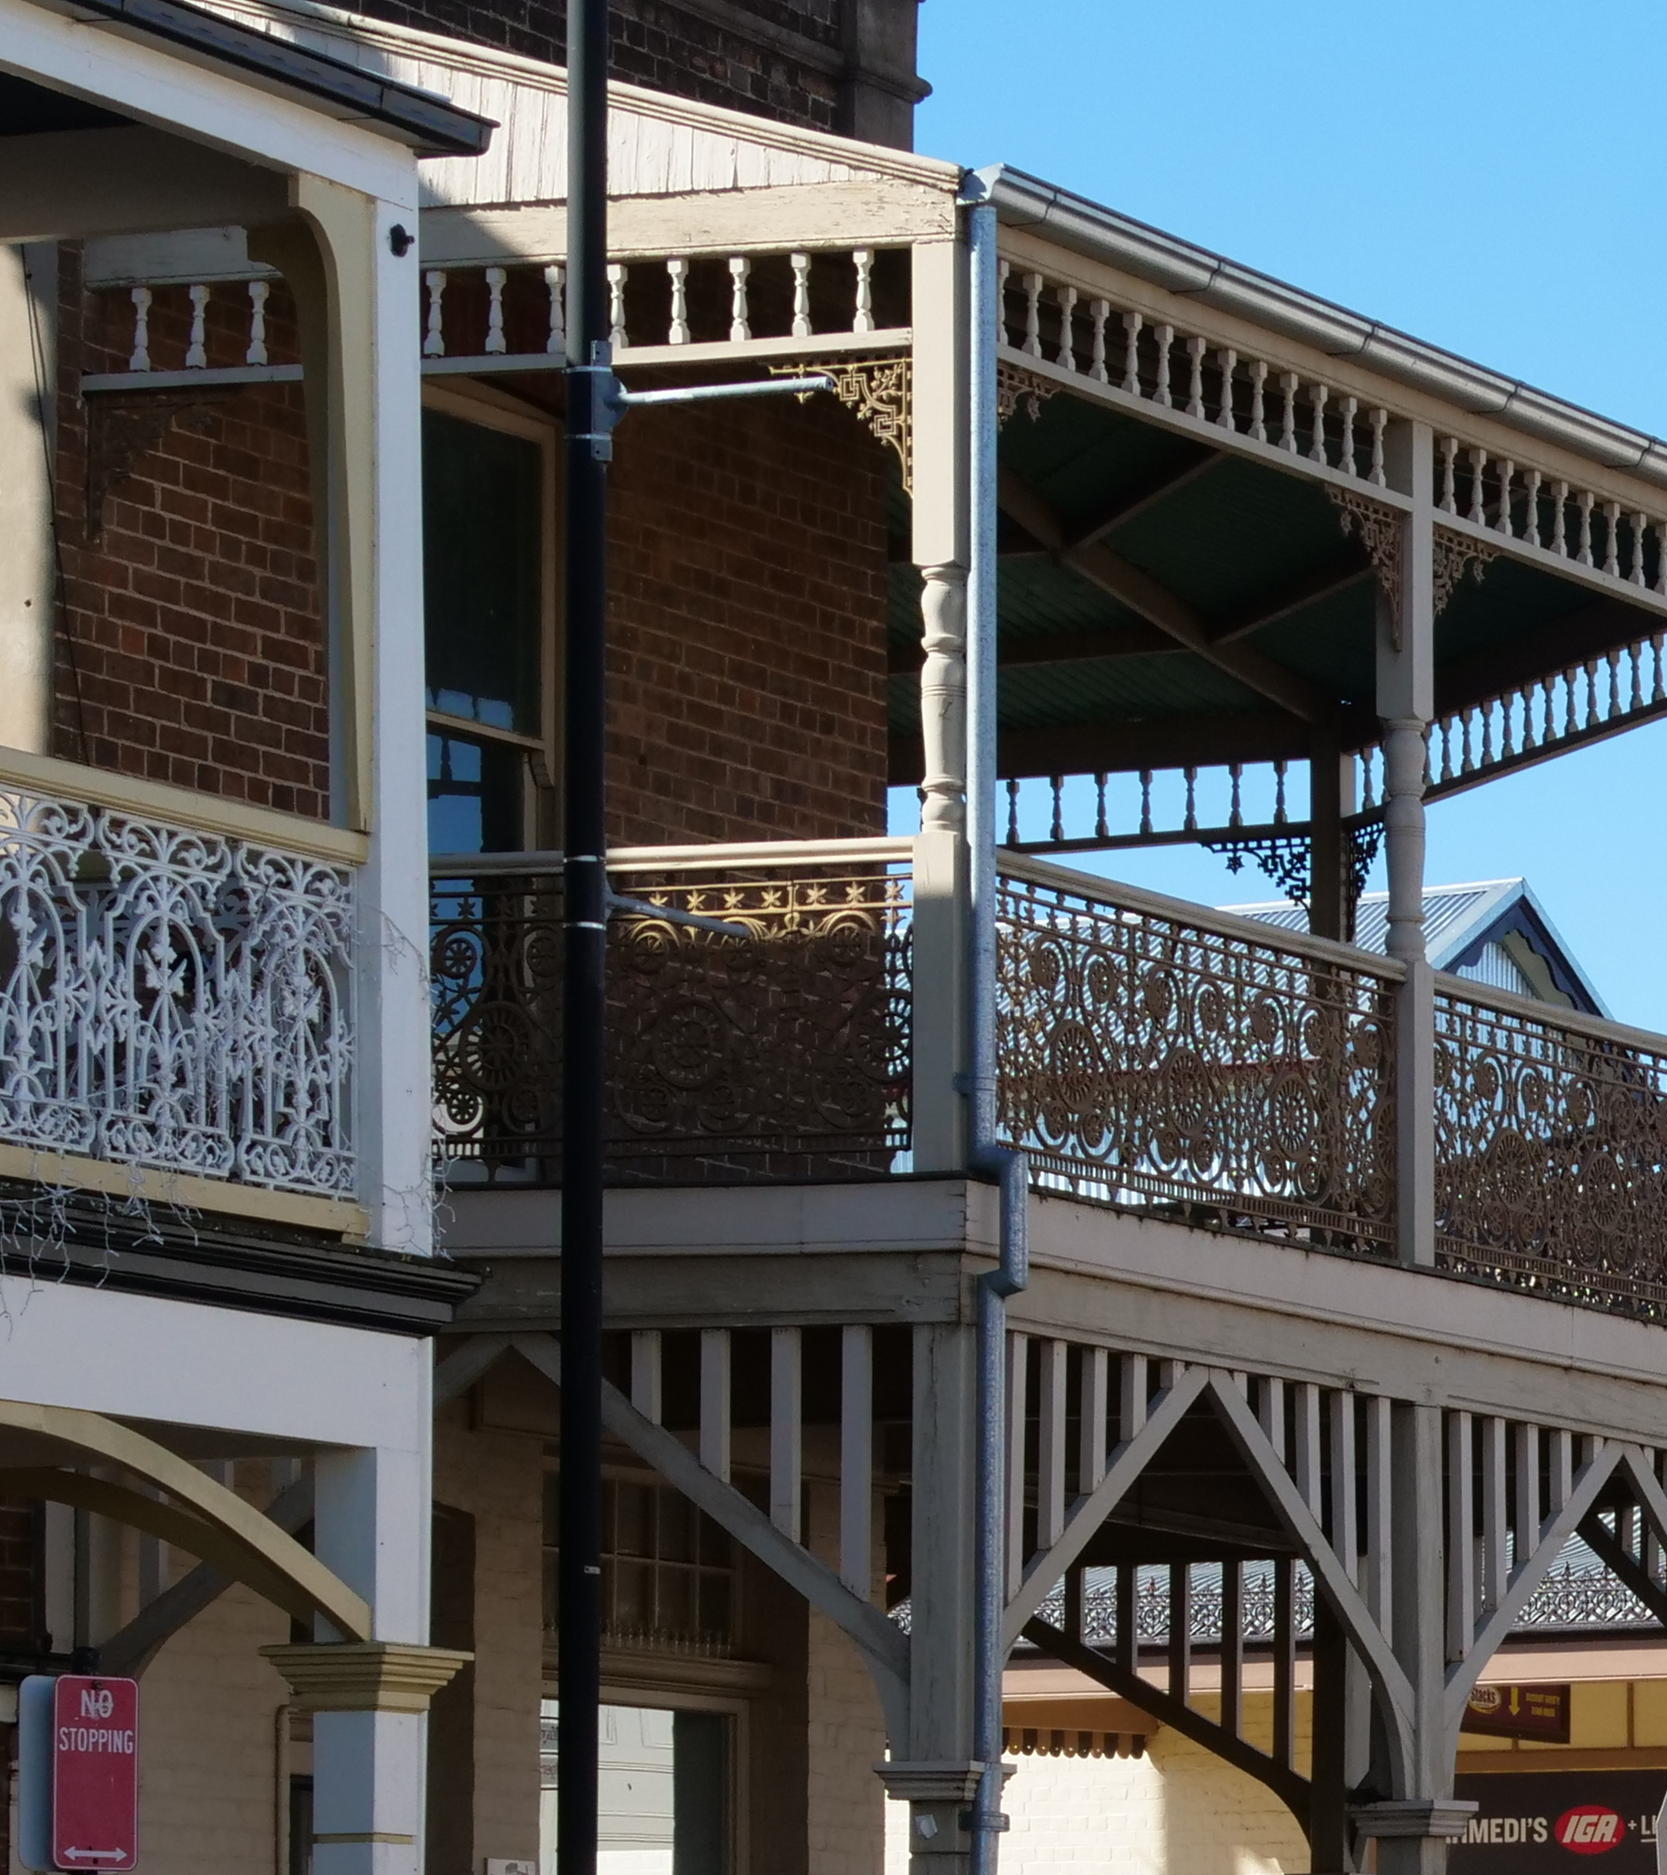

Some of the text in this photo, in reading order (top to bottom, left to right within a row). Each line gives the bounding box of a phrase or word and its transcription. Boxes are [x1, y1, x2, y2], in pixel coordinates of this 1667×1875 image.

[81, 1688, 114, 1719] NO
[59, 1726, 134, 1755] STOPPING
[1446, 1817, 1548, 1845] MEDI'S
[1562, 1814, 1618, 1844] IGA
